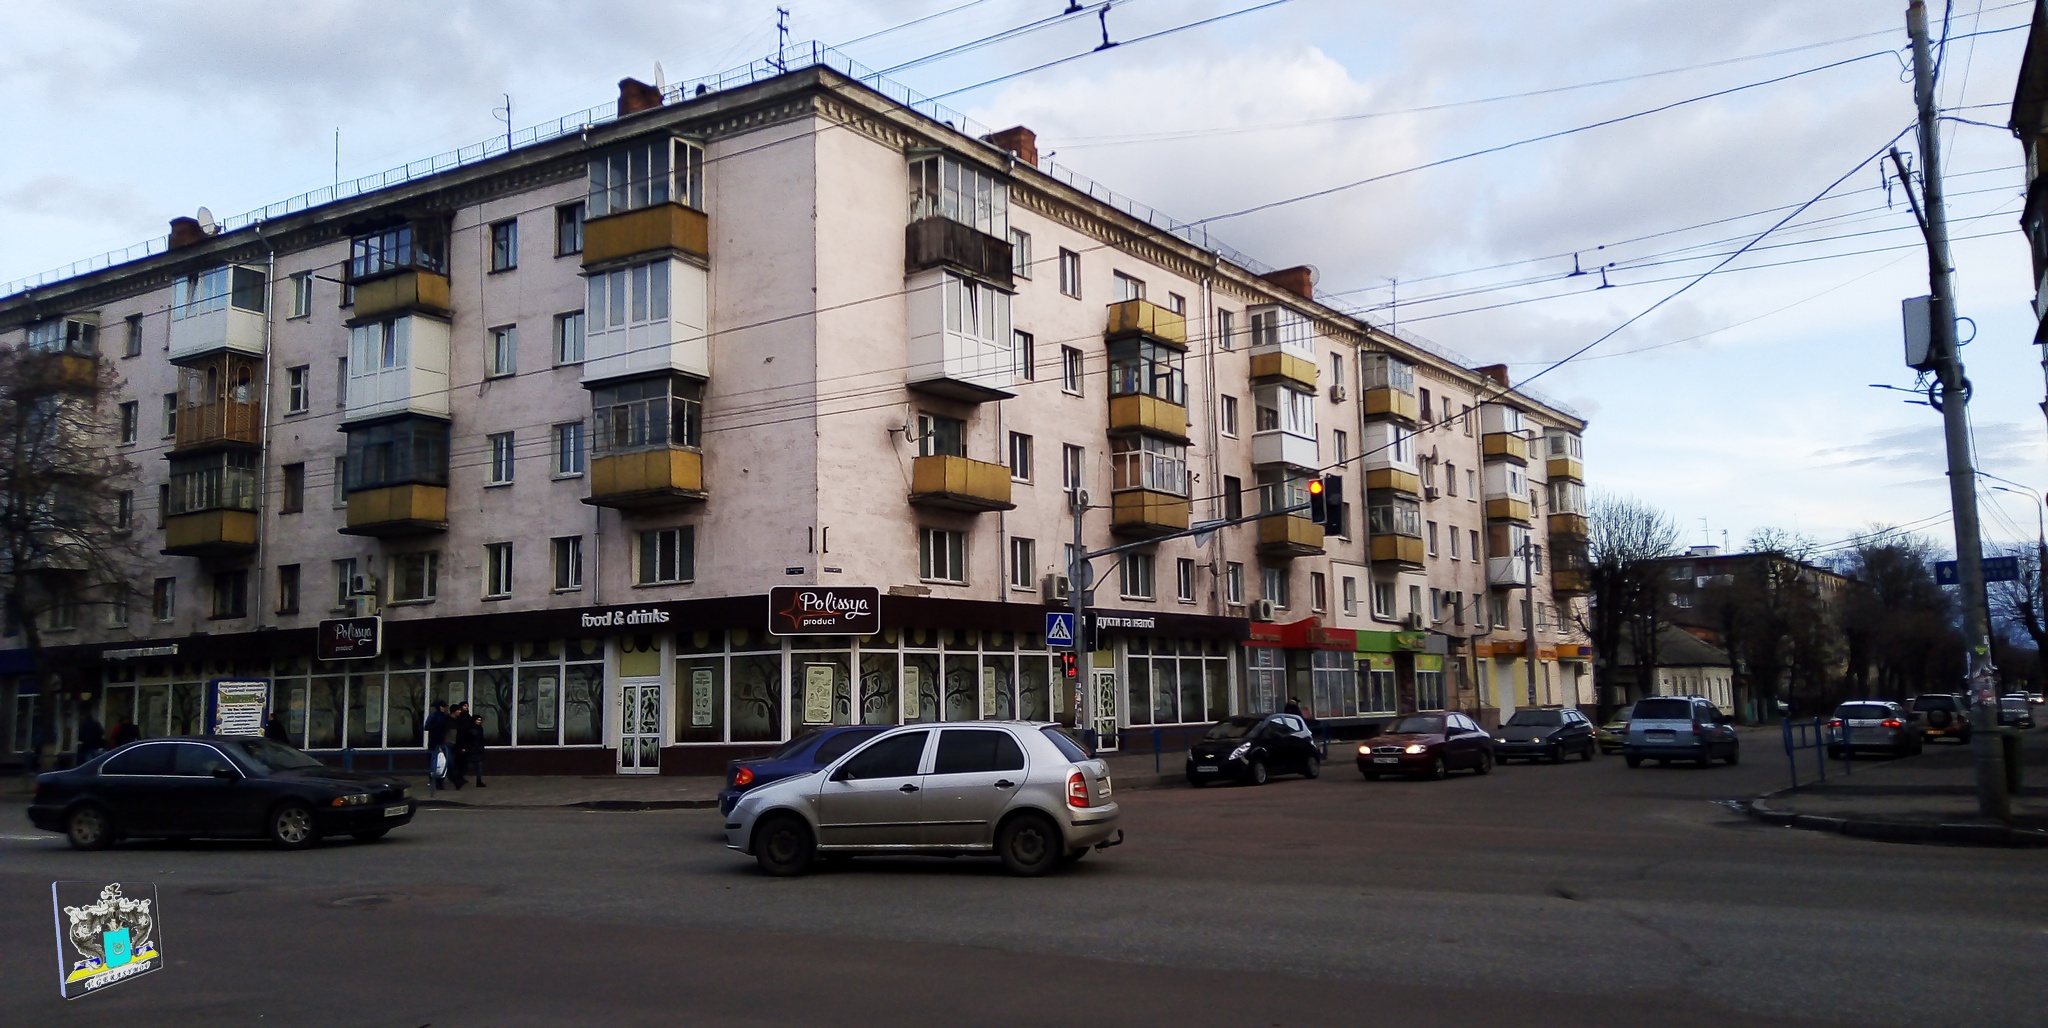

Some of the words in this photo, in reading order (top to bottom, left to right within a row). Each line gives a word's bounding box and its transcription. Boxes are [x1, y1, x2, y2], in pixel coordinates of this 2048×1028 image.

[799, 592, 872, 619] Polissya
[581, 612, 613, 627] food
[613, 611, 625, 625] &
[626, 609, 670, 625] drinks
[803, 618, 836, 627] product
[335, 622, 373, 646] Polissya
